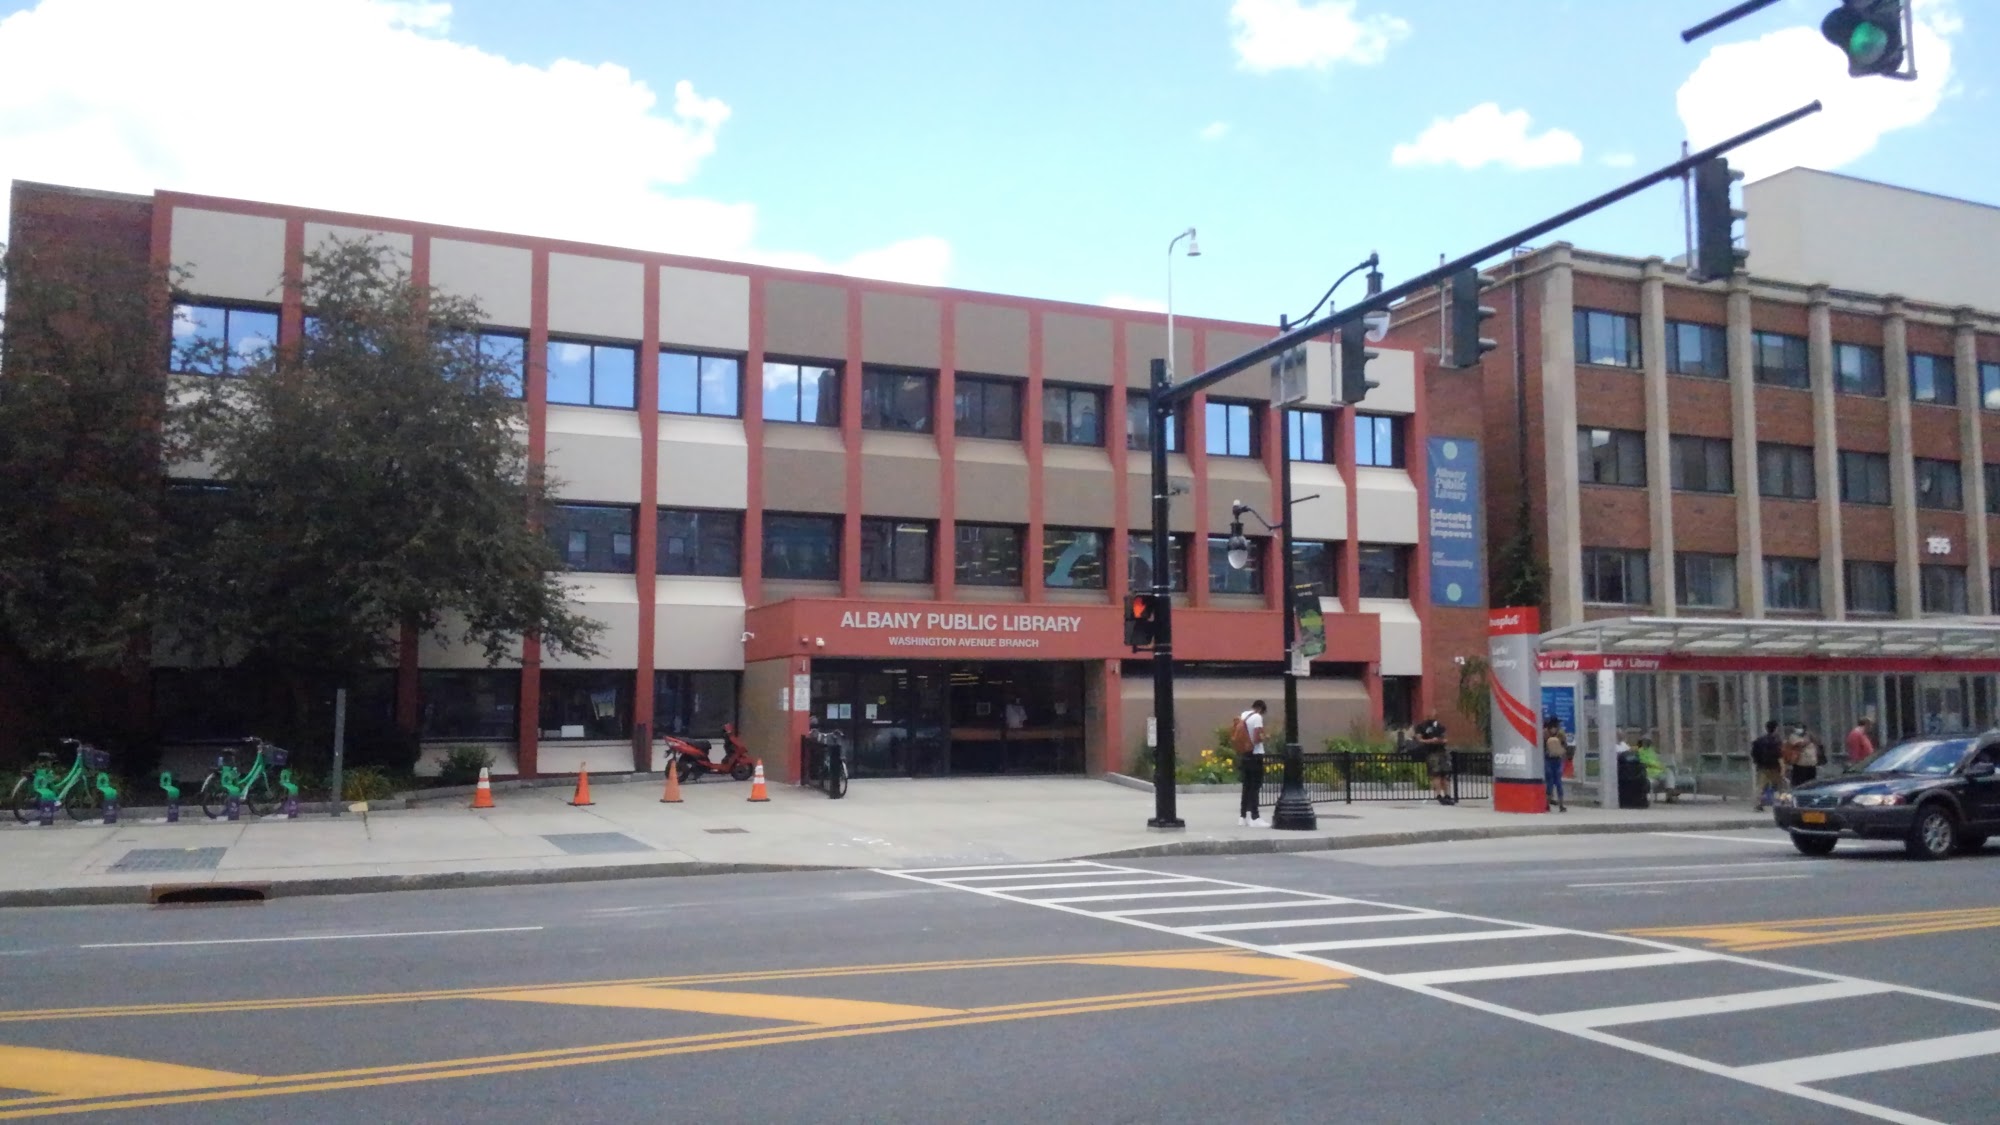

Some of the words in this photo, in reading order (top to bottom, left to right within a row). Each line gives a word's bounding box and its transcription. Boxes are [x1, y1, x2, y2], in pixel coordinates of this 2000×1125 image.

[1435, 488, 1466, 502] Library
[840, 611, 922, 629] ALBANY
[927, 614, 998, 631] PUBLIC
[1003, 616, 1082, 632] LIBRARY
[888, 636, 957, 647] WASHINGTON
[958, 637, 997, 648] AVENUE
[999, 638, 1040, 649] BRANCH
[1549, 659, 1579, 669] Library
[1603, 658, 1624, 668] Lark
[1629, 658, 1660, 669] Library
